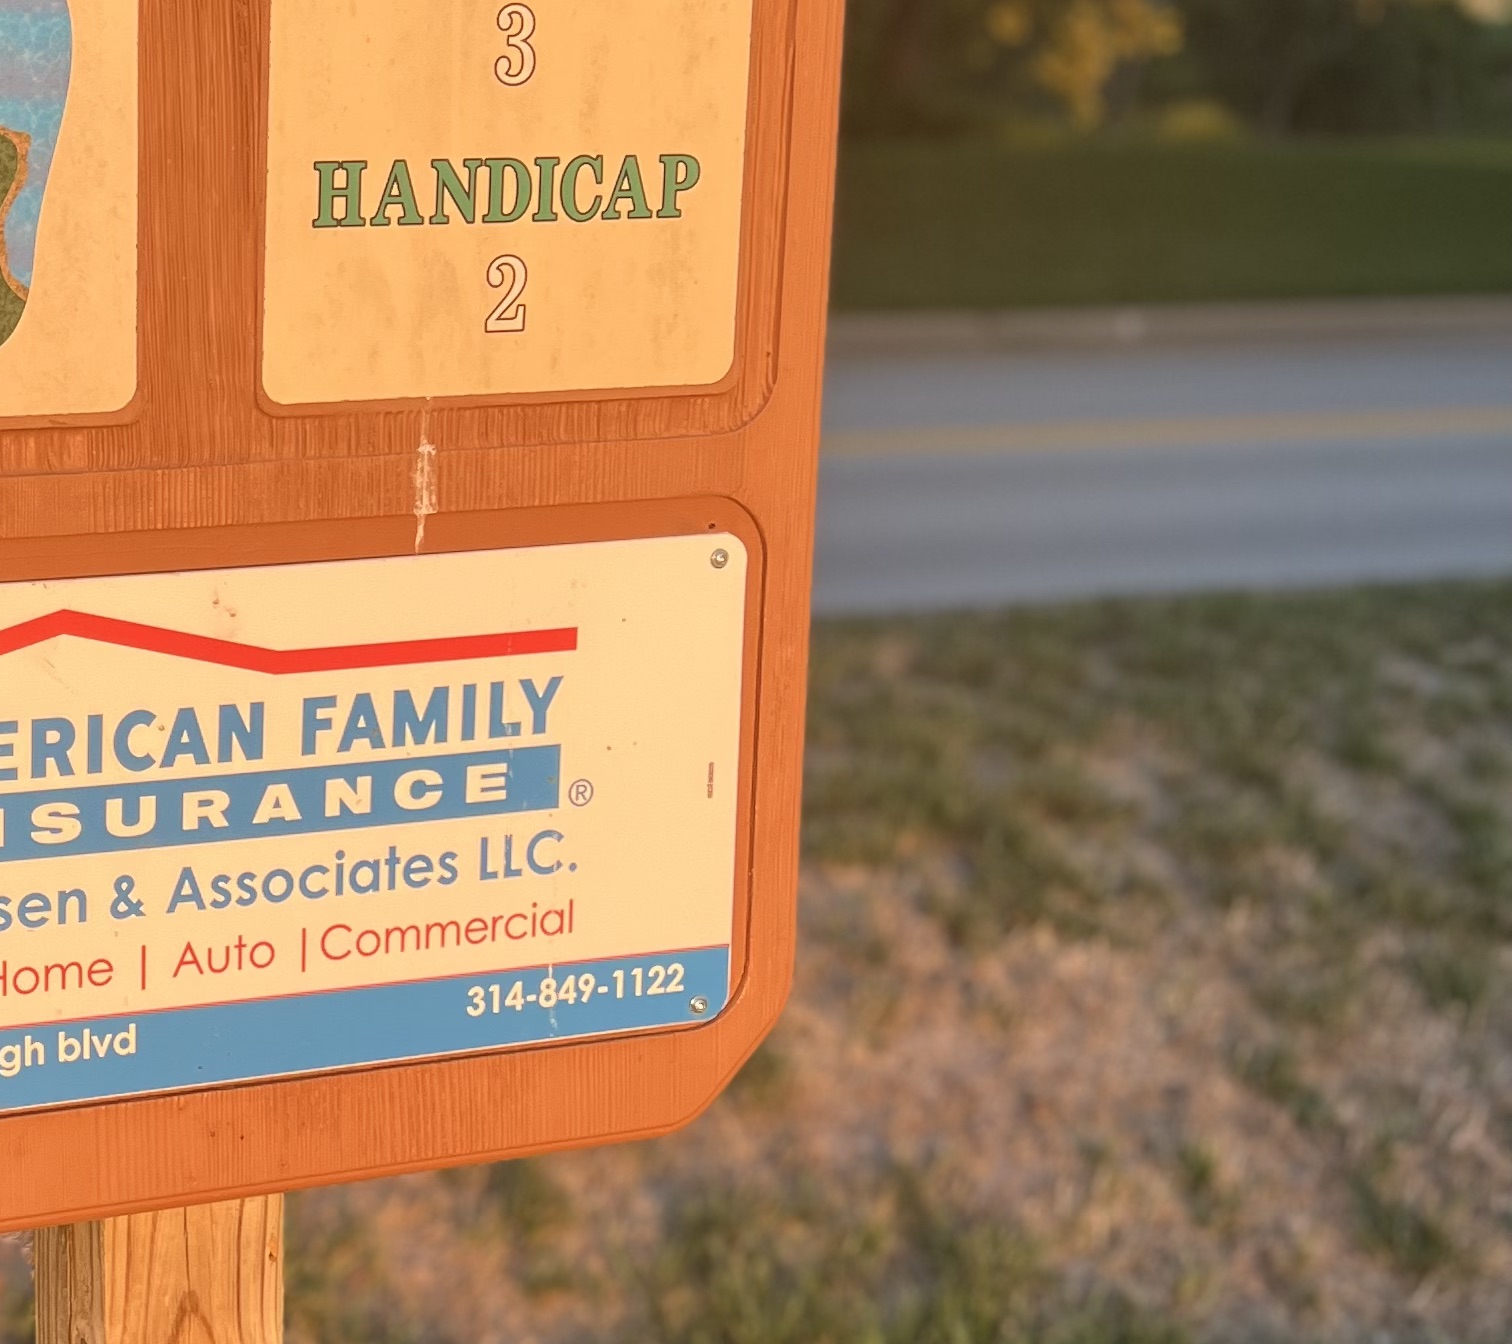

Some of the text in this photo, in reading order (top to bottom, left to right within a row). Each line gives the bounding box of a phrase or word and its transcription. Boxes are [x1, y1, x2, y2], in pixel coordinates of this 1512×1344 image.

[494, 2, 537, 86] 3
[311, 153, 701, 229] HANDICAP
[484, 253, 528, 334] 2
[301, 675, 564, 756] FAMILY
[110, 874, 145, 919] &
[166, 845, 459, 914] Associates
[478, 829, 578, 881] LLC.
[173, 934, 276, 978] Auto
[320, 899, 574, 960] Commercial
[465, 962, 685, 1017] 314-849-1122
[58, 1022, 137, 1063] blvd
